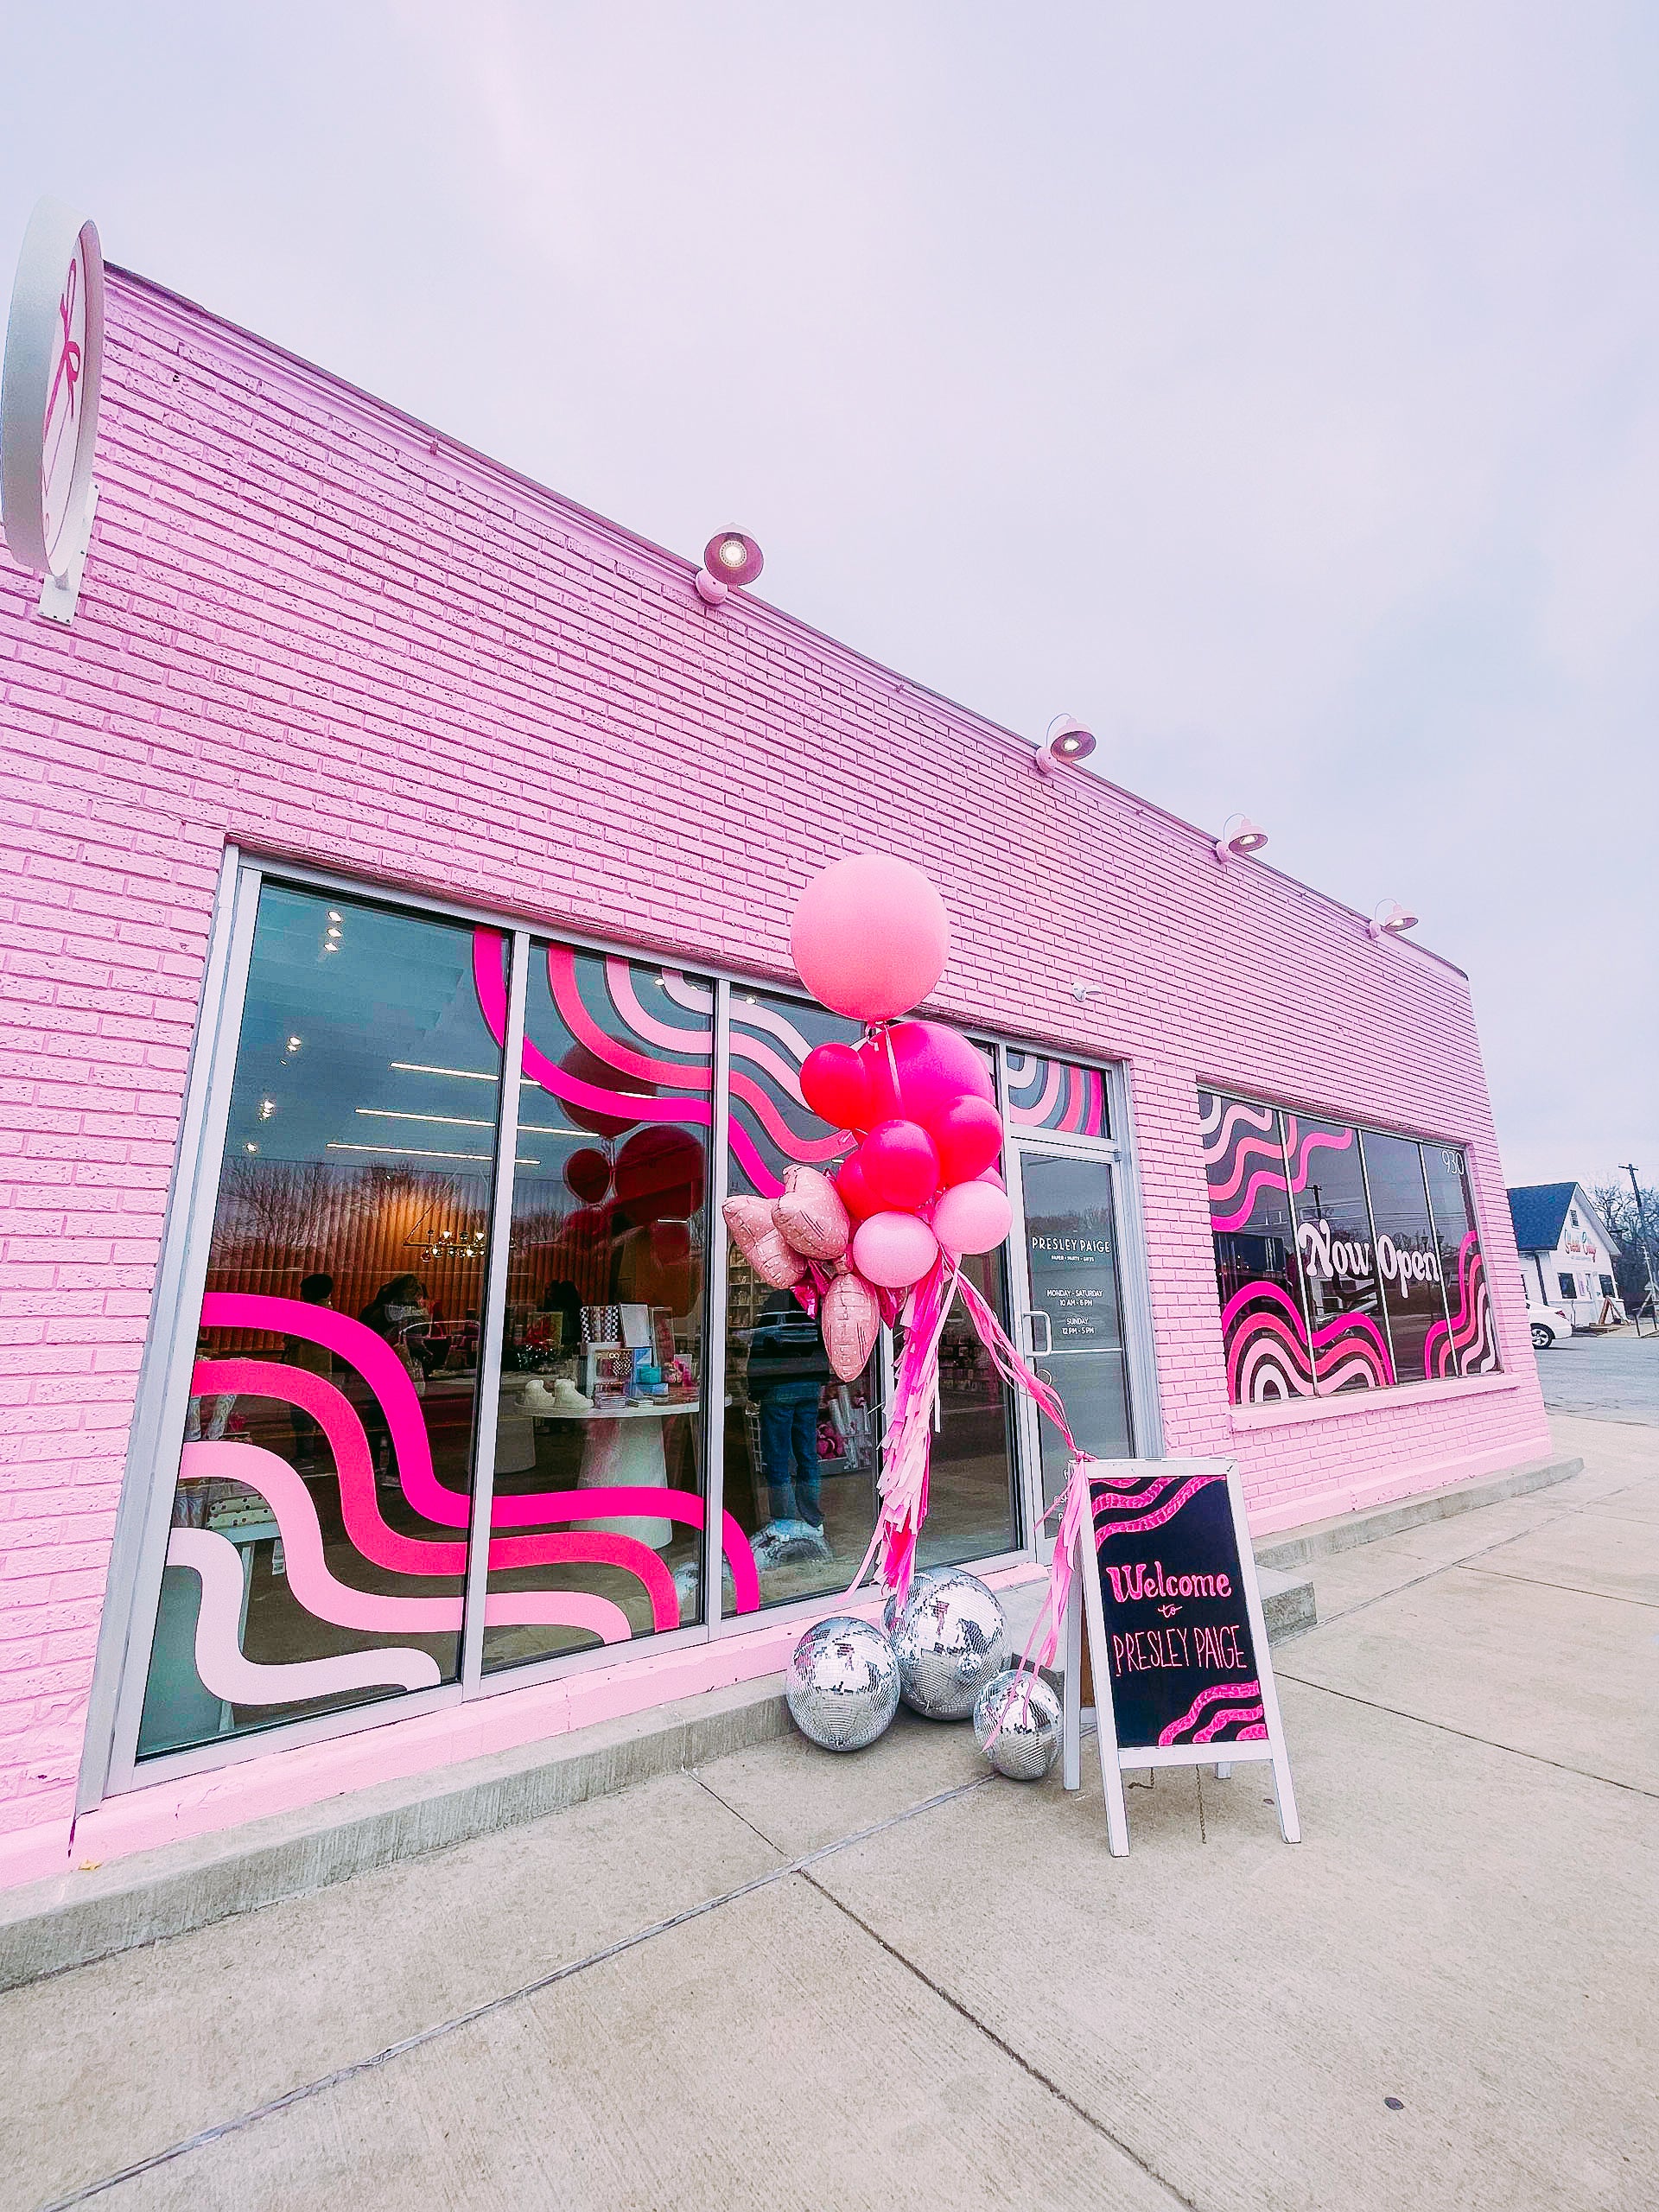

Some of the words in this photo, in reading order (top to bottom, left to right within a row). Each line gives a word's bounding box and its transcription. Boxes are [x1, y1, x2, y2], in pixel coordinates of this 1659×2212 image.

[1441, 1150, 1464, 1175] 930
[1032, 1236, 1077, 1251] PRESLEY
[1080, 1240, 1110, 1253] PAIGE
[1298, 1218, 1370, 1277] Now
[1378, 1234, 1440, 1299] Open
[1075, 1289, 1103, 1298] SATURDAY
[1085, 1325, 1095, 1334] PM
[1106, 1560, 1232, 1603] Welcome
[1157, 1603, 1183, 1618] to
[1113, 1627, 1190, 1677] PRESLEY
[1194, 1625, 1248, 1669] PAIGE
